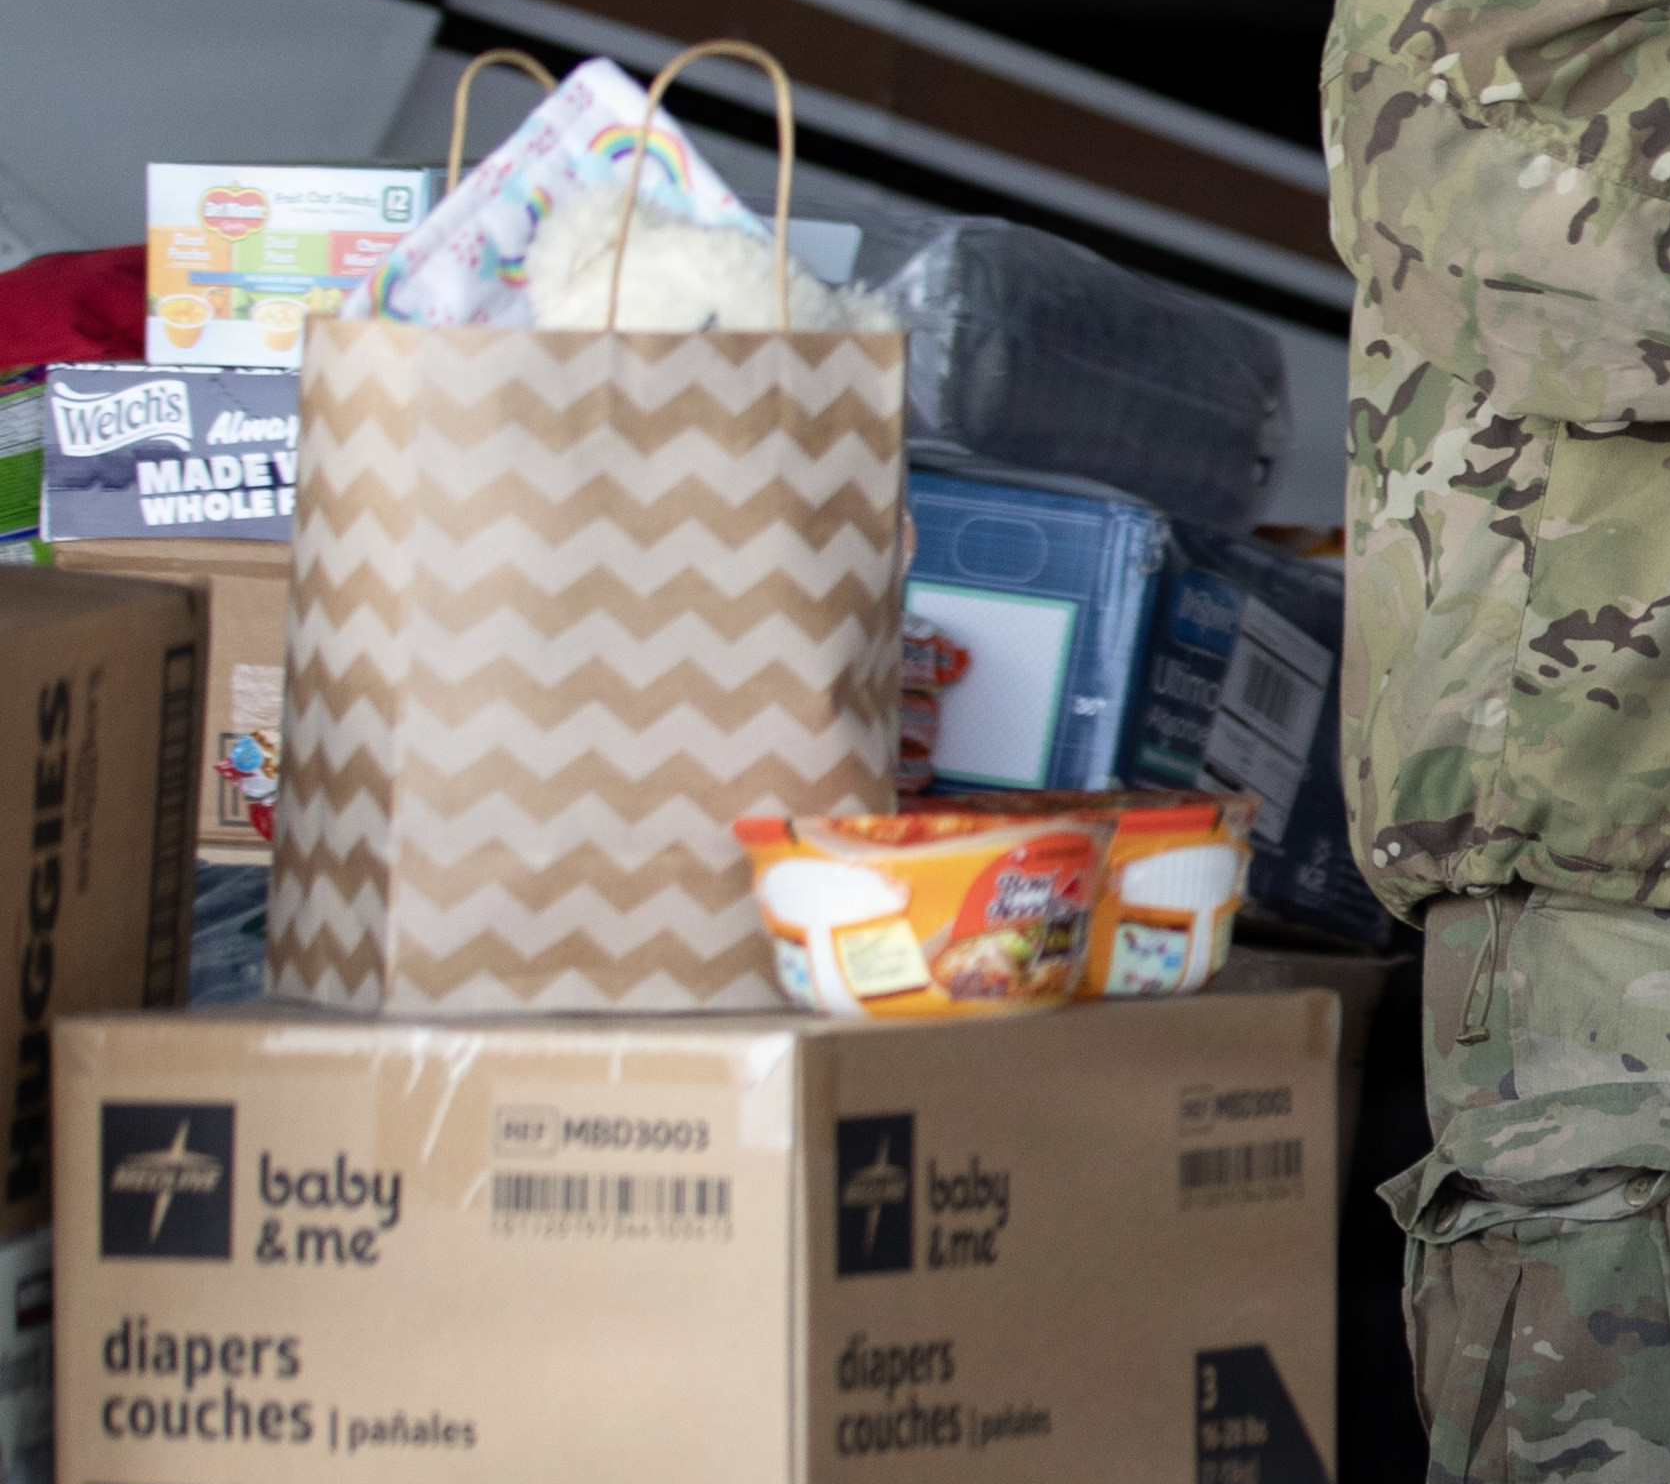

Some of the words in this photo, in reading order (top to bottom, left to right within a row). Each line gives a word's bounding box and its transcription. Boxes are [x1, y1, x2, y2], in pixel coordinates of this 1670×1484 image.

[385, 190, 409, 211] 12
[59, 380, 188, 448] Welch's
[137, 452, 274, 495] MADE
[140, 492, 275, 526] WHOLE
[257, 1152, 404, 1228] baby
[928, 1161, 1010, 1227] baby
[101, 1317, 303, 1390] diapers
[836, 1332, 955, 1401] diapers
[1202, 1364, 1218, 1410] 3
[100, 1393, 315, 1443] couches
[348, 1409, 478, 1456] pañales
[836, 1396, 961, 1458] couches
